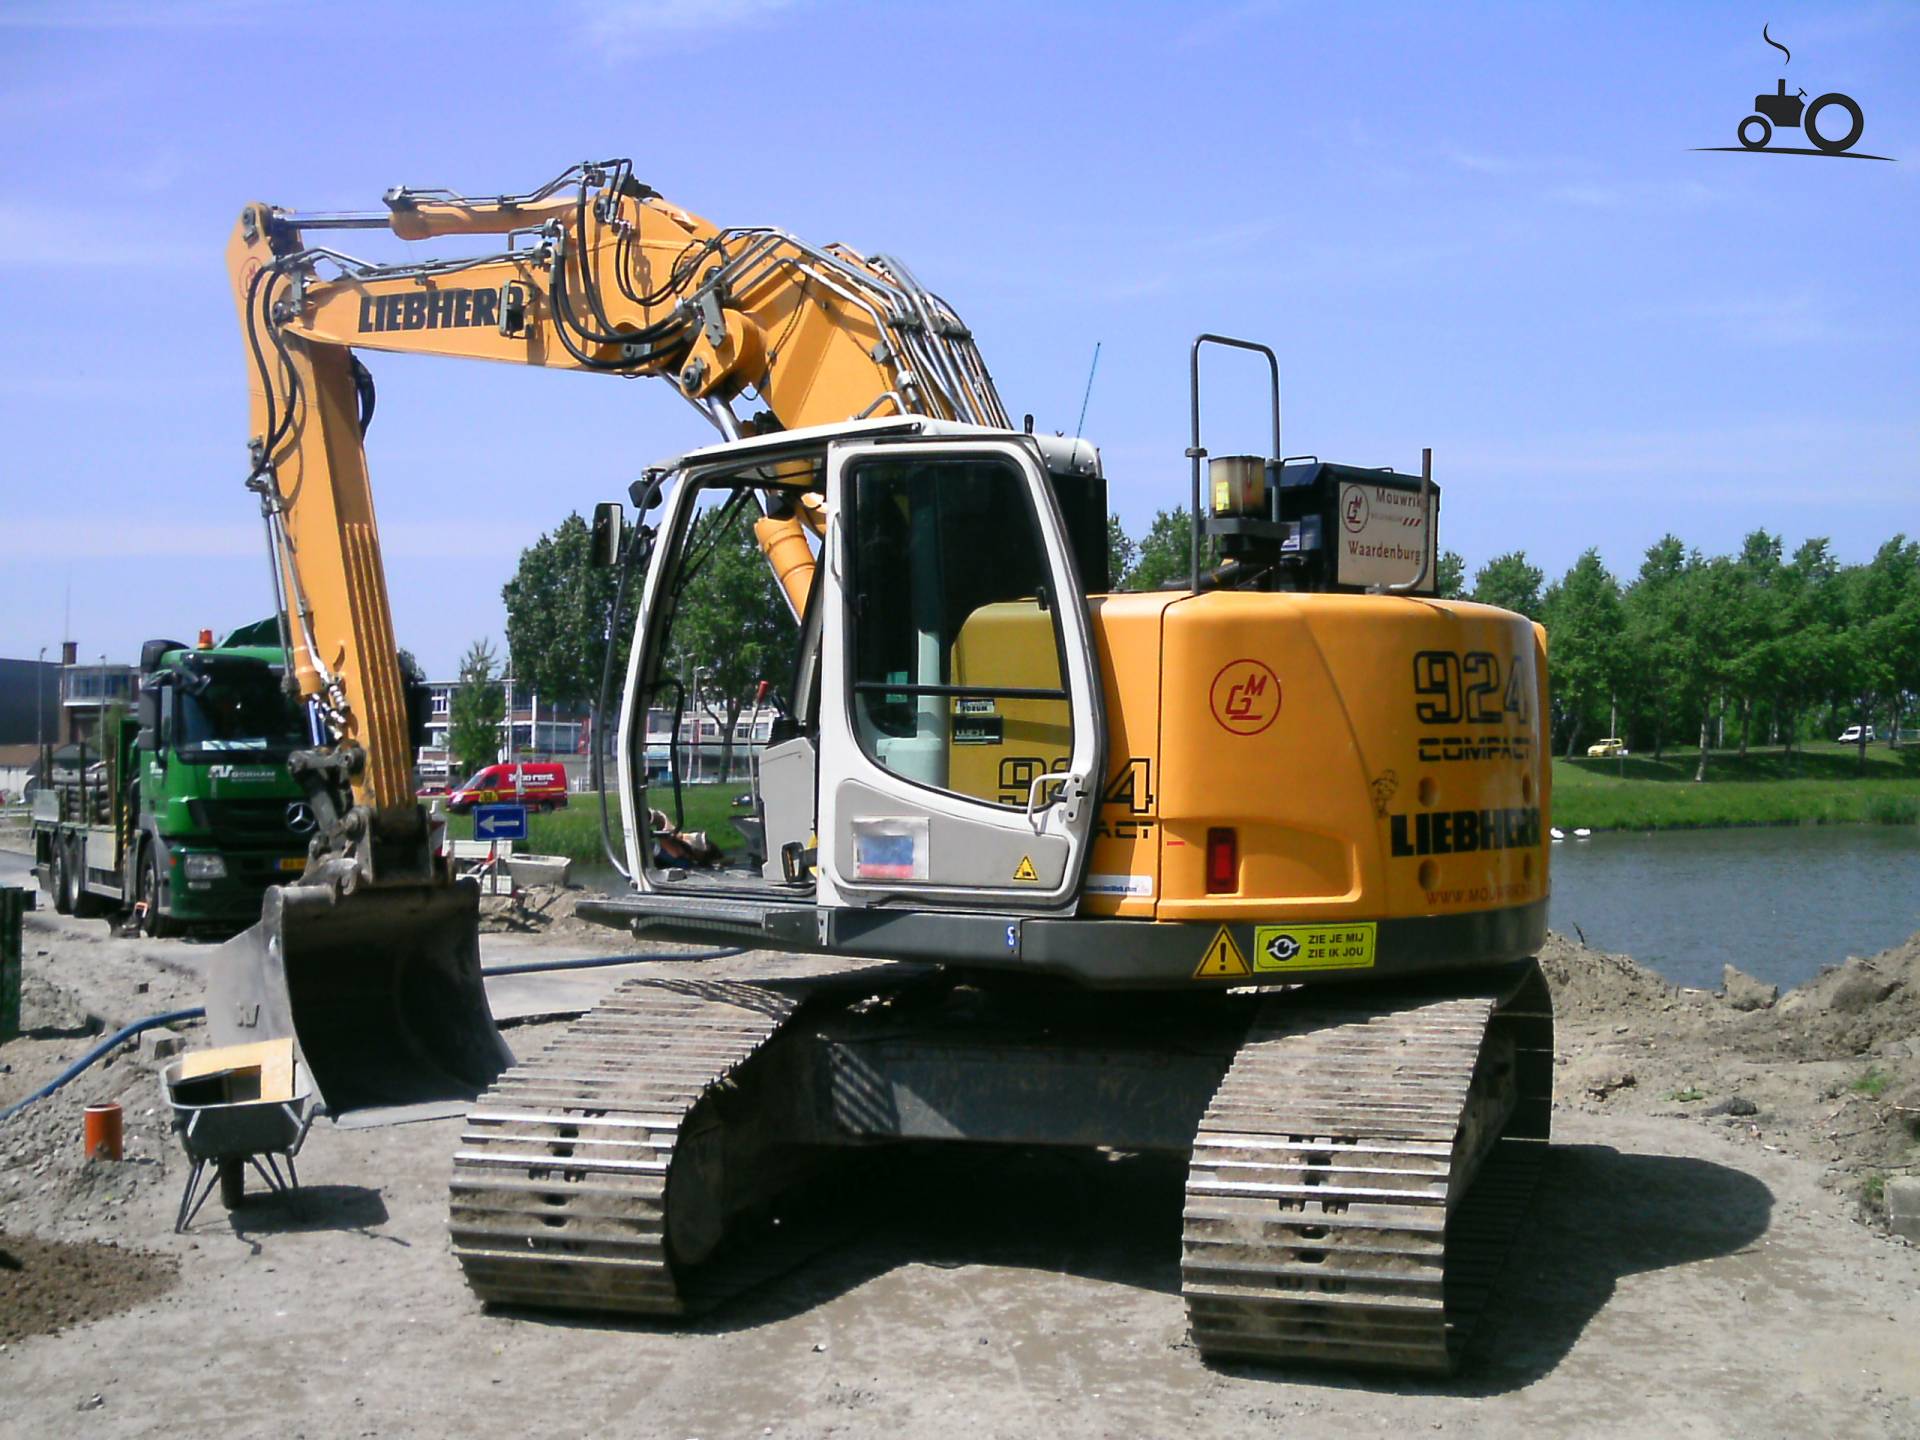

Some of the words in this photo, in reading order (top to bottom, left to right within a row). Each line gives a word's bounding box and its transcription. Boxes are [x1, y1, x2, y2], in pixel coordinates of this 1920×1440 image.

[1348, 541, 1420, 565] Waardenburg
[1413, 650, 1528, 724] 924
[1418, 737, 1530, 762] COMPACT
[1308, 935, 1326, 944] ZIE
[1329, 933, 1343, 943] JE
[1346, 932, 1363, 942] MIJ
[1308, 948, 1326, 958] ZIE
[1328, 948, 1340, 957] IK
[1342, 946, 1364, 957] JOU
